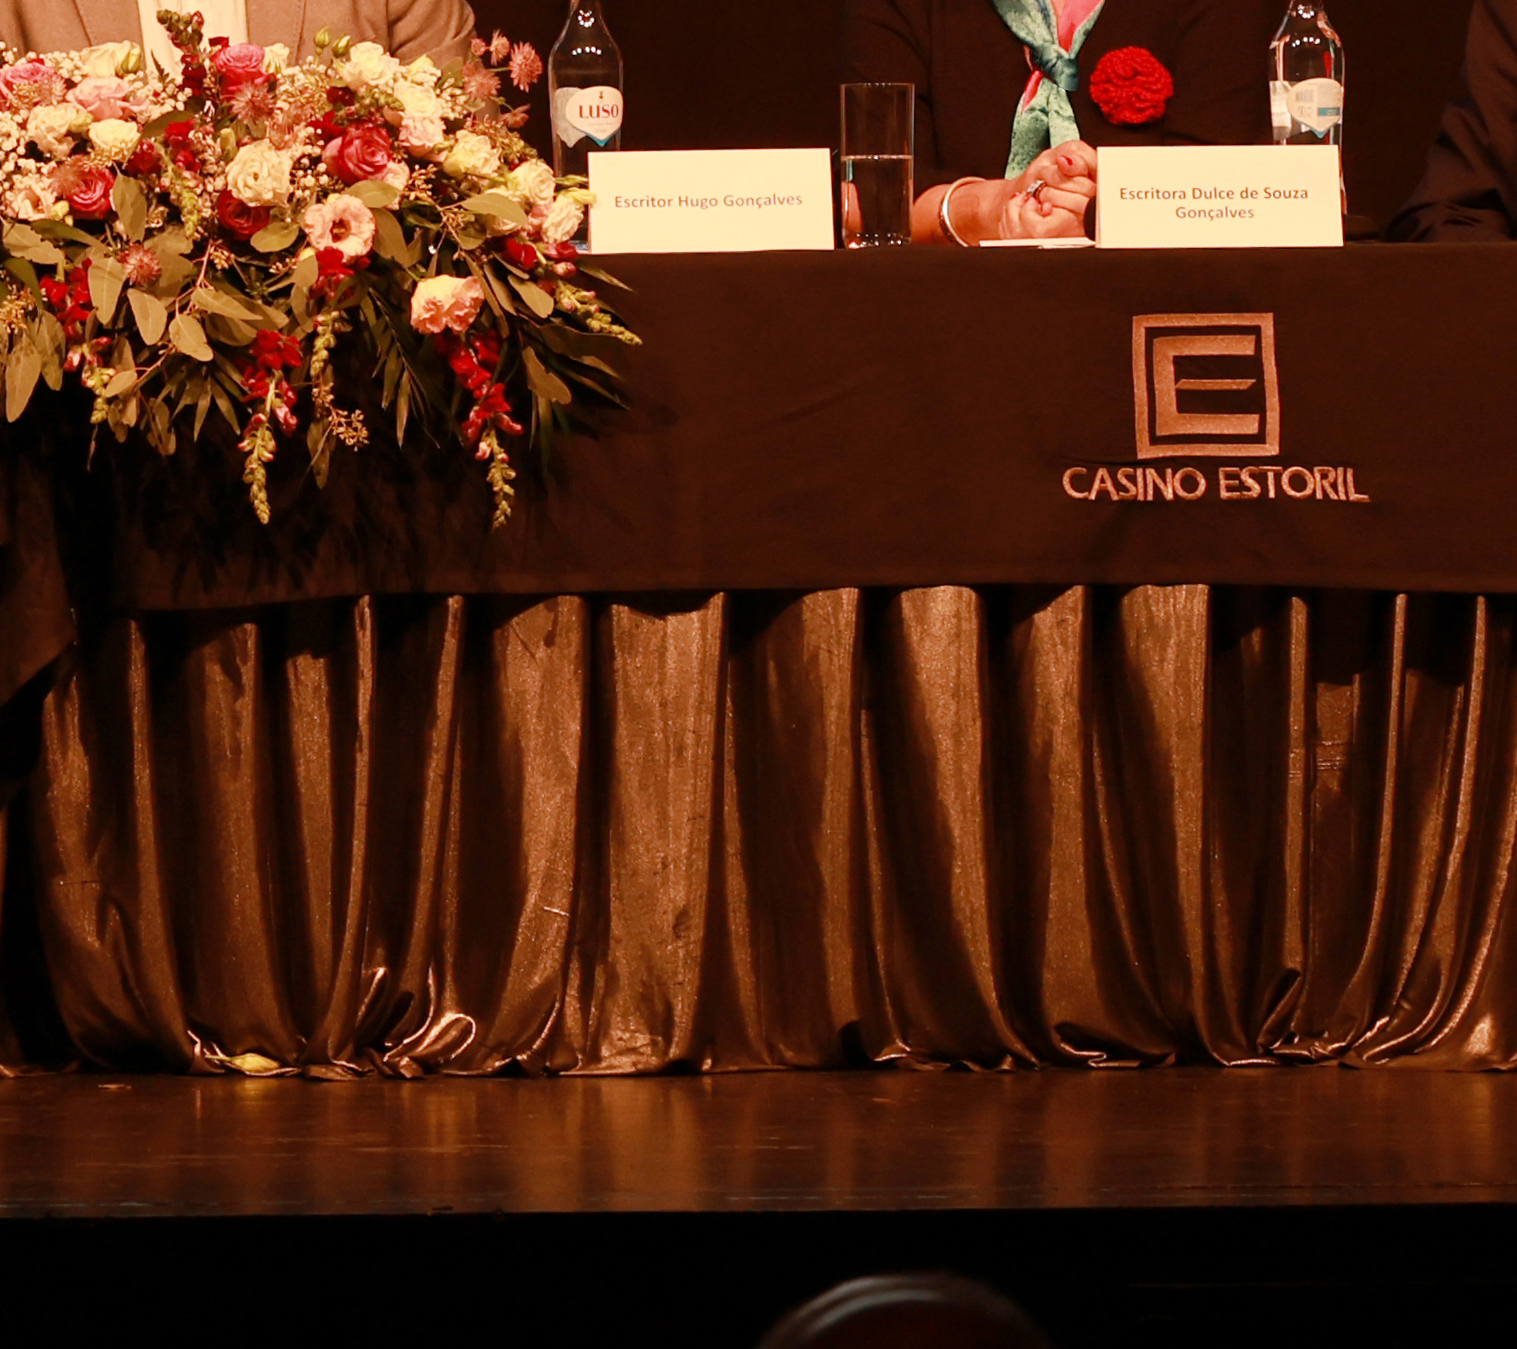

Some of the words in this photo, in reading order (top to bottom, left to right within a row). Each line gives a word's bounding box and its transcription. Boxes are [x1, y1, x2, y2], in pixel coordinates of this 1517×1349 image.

[578, 103, 619, 119] LUSO
[1119, 187, 1186, 200] Escritora
[1192, 187, 1235, 200] Dulce
[1240, 187, 1258, 200] de
[1264, 186, 1309, 200] Souza
[614, 195, 673, 208] Escritor
[678, 195, 718, 210] Hugo
[723, 193, 803, 210] Gonçalves
[1175, 206, 1255, 221] Gonçalves
[1062, 467, 1207, 501] CASINO
[1218, 466, 1371, 502] ESTORIL
